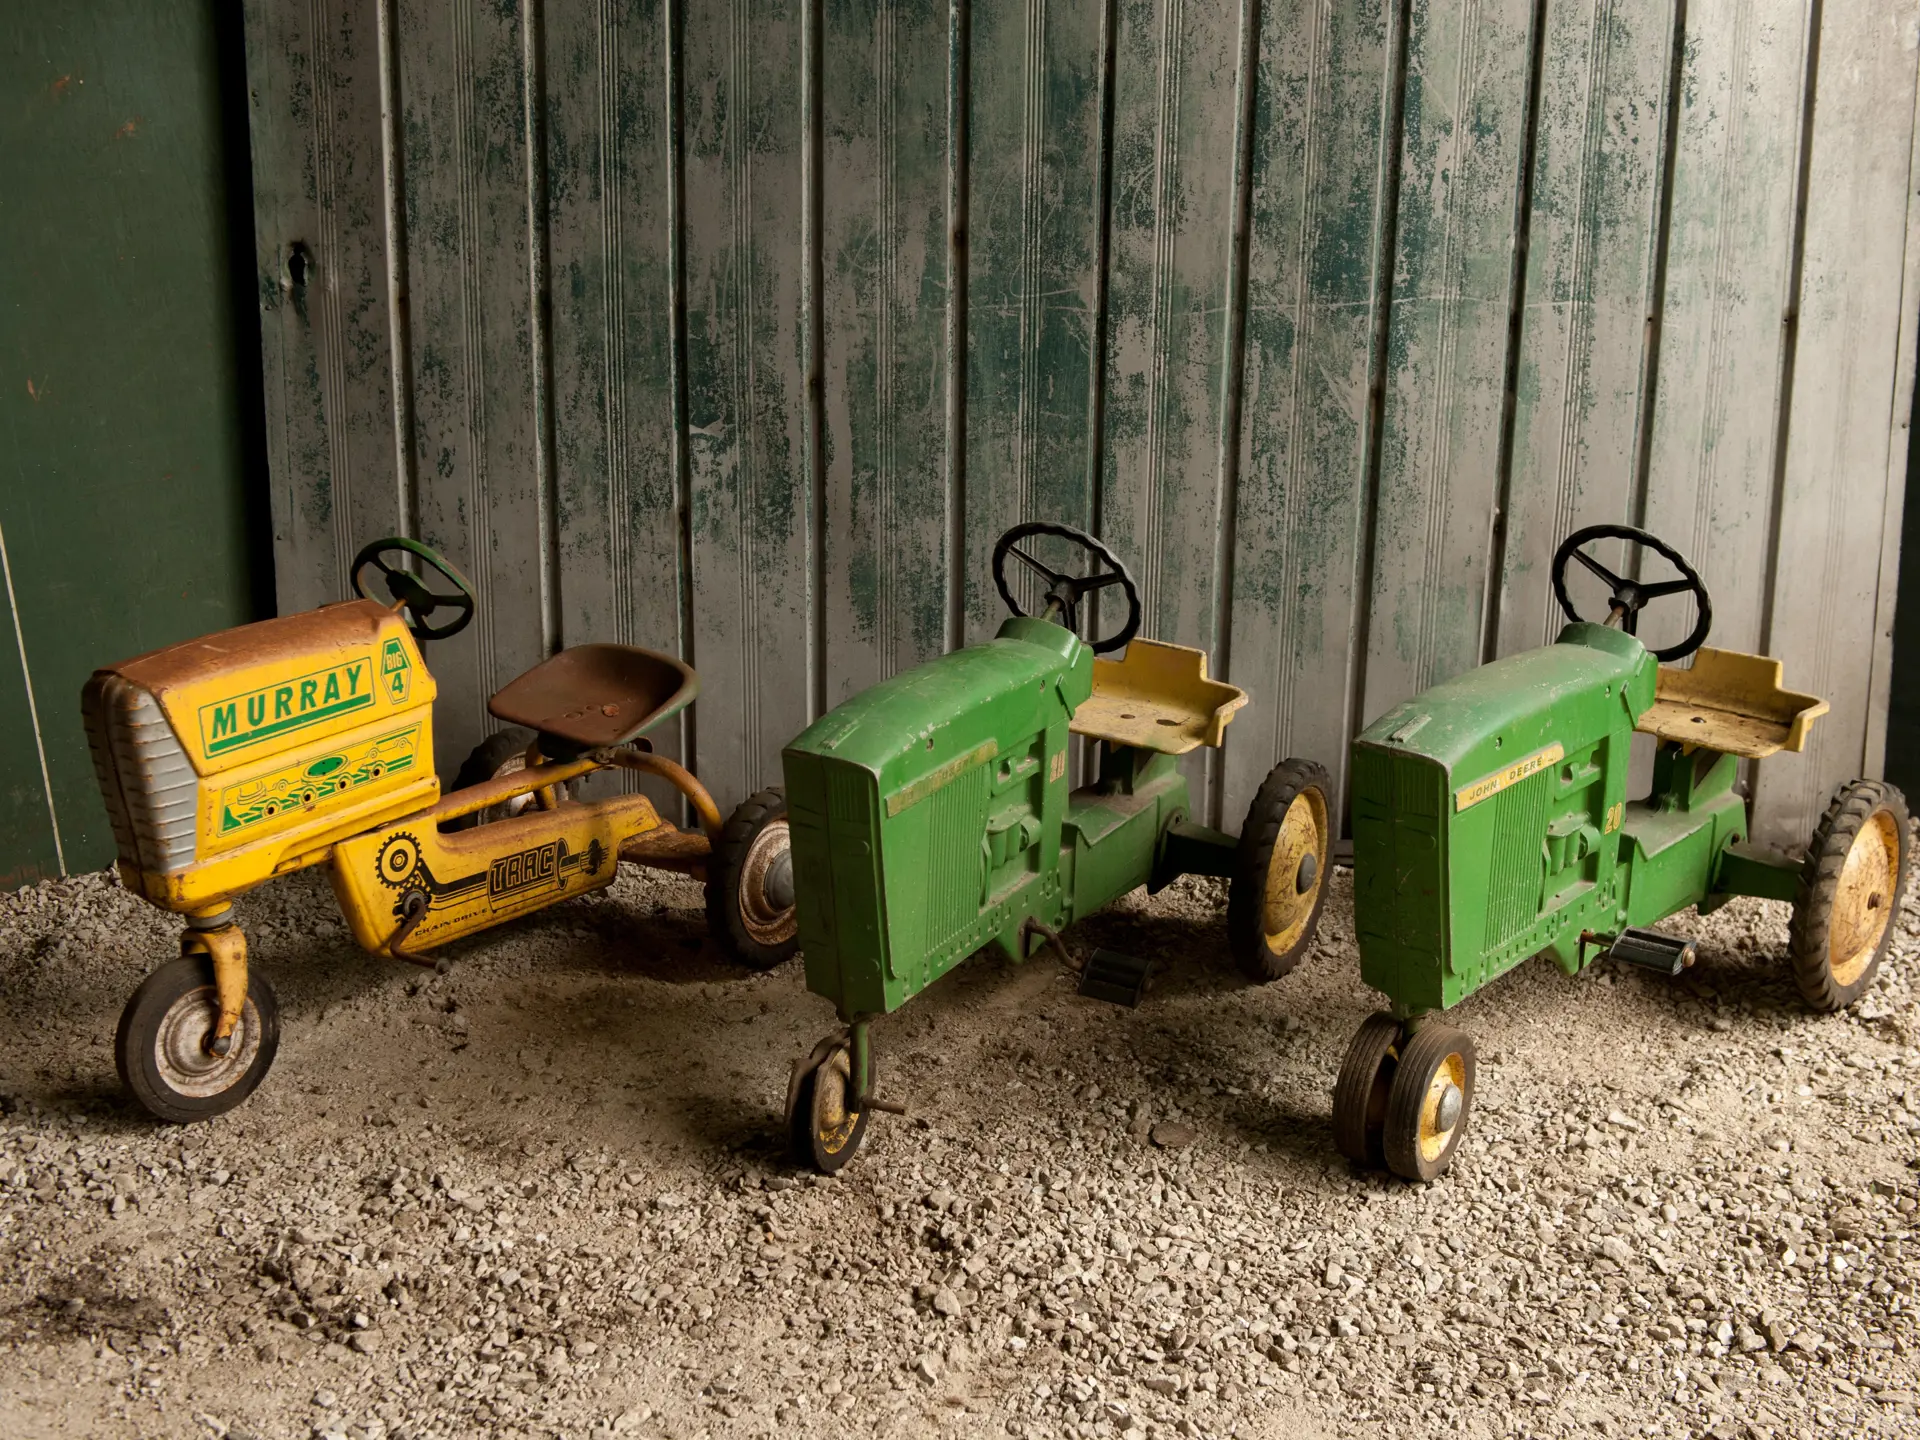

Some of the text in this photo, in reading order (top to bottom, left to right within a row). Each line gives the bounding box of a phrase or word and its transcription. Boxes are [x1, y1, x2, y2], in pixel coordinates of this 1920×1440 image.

[387, 651, 403, 670] BIG
[391, 672, 404, 694] 4
[212, 664, 362, 739] MURRAY
[1470, 757, 1543, 799] JOHN DEERE
[1604, 802, 1622, 835] 20
[491, 845, 554, 892] TRAC
[415, 908, 487, 936] CHAIN DRIVE
